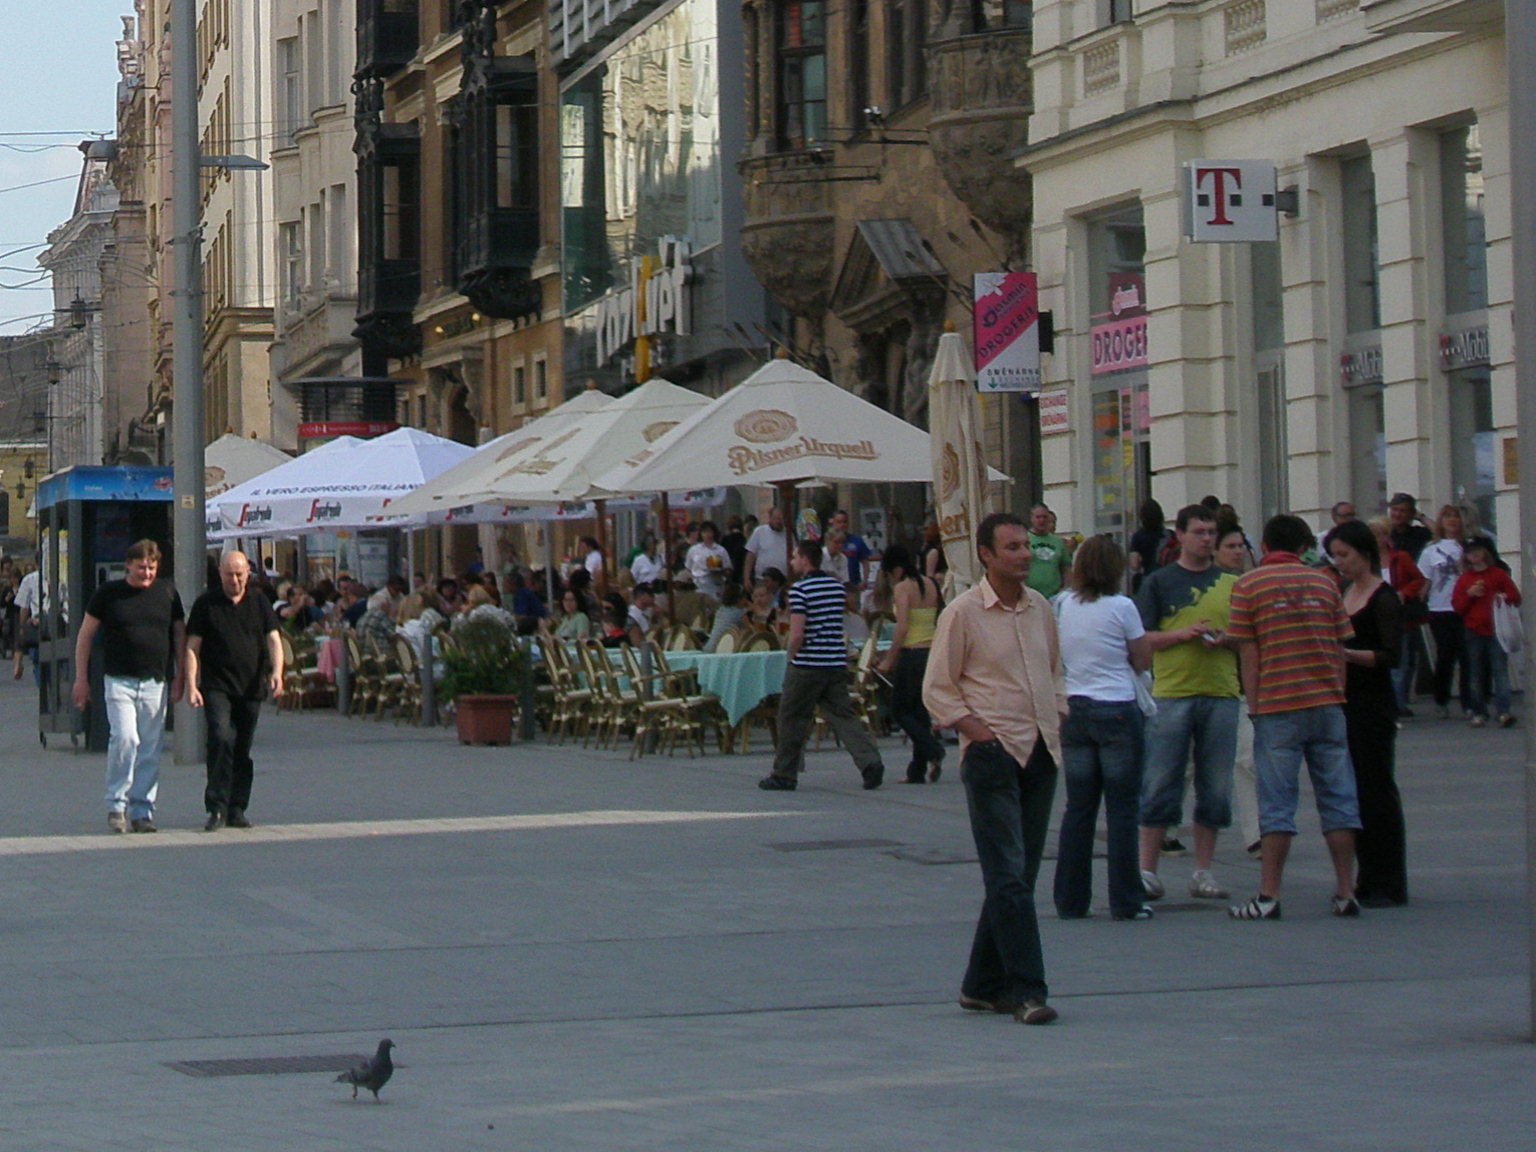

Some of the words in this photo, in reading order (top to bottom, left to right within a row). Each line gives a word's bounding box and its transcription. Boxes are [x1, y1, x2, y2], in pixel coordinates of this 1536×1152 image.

[1196, 168, 1242, 226] T
[728, 438, 802, 476] Pilsner
[300, 484, 367, 494] ESPRESSO
